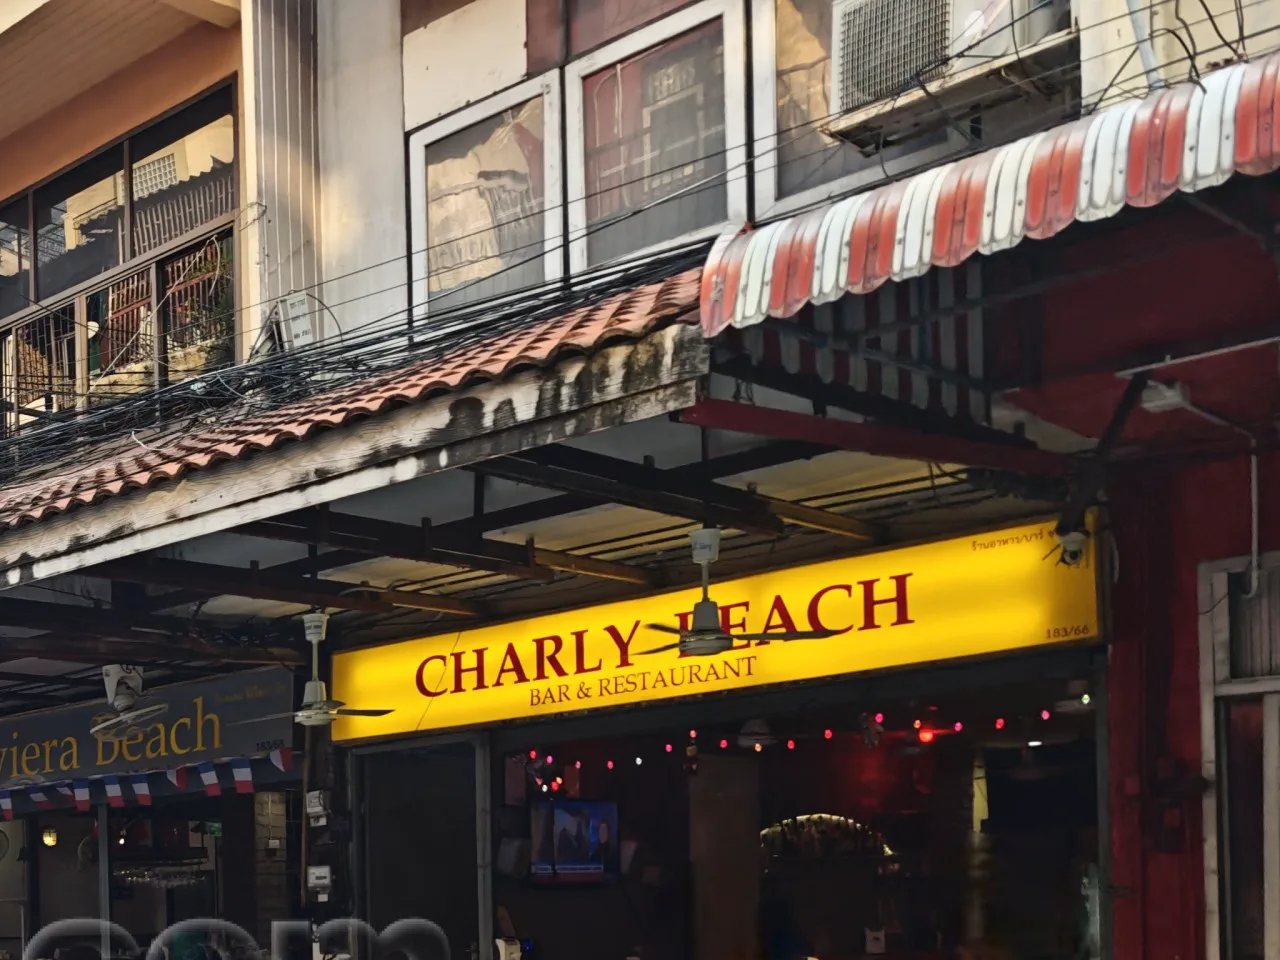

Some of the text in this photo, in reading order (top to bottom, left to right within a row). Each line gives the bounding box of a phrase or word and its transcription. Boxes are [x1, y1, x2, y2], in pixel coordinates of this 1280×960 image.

[415, 619, 641, 699] CHARLY
[529, 655, 757, 708] BAR & RESTAURANT
[91, 696, 223, 766] Beach
